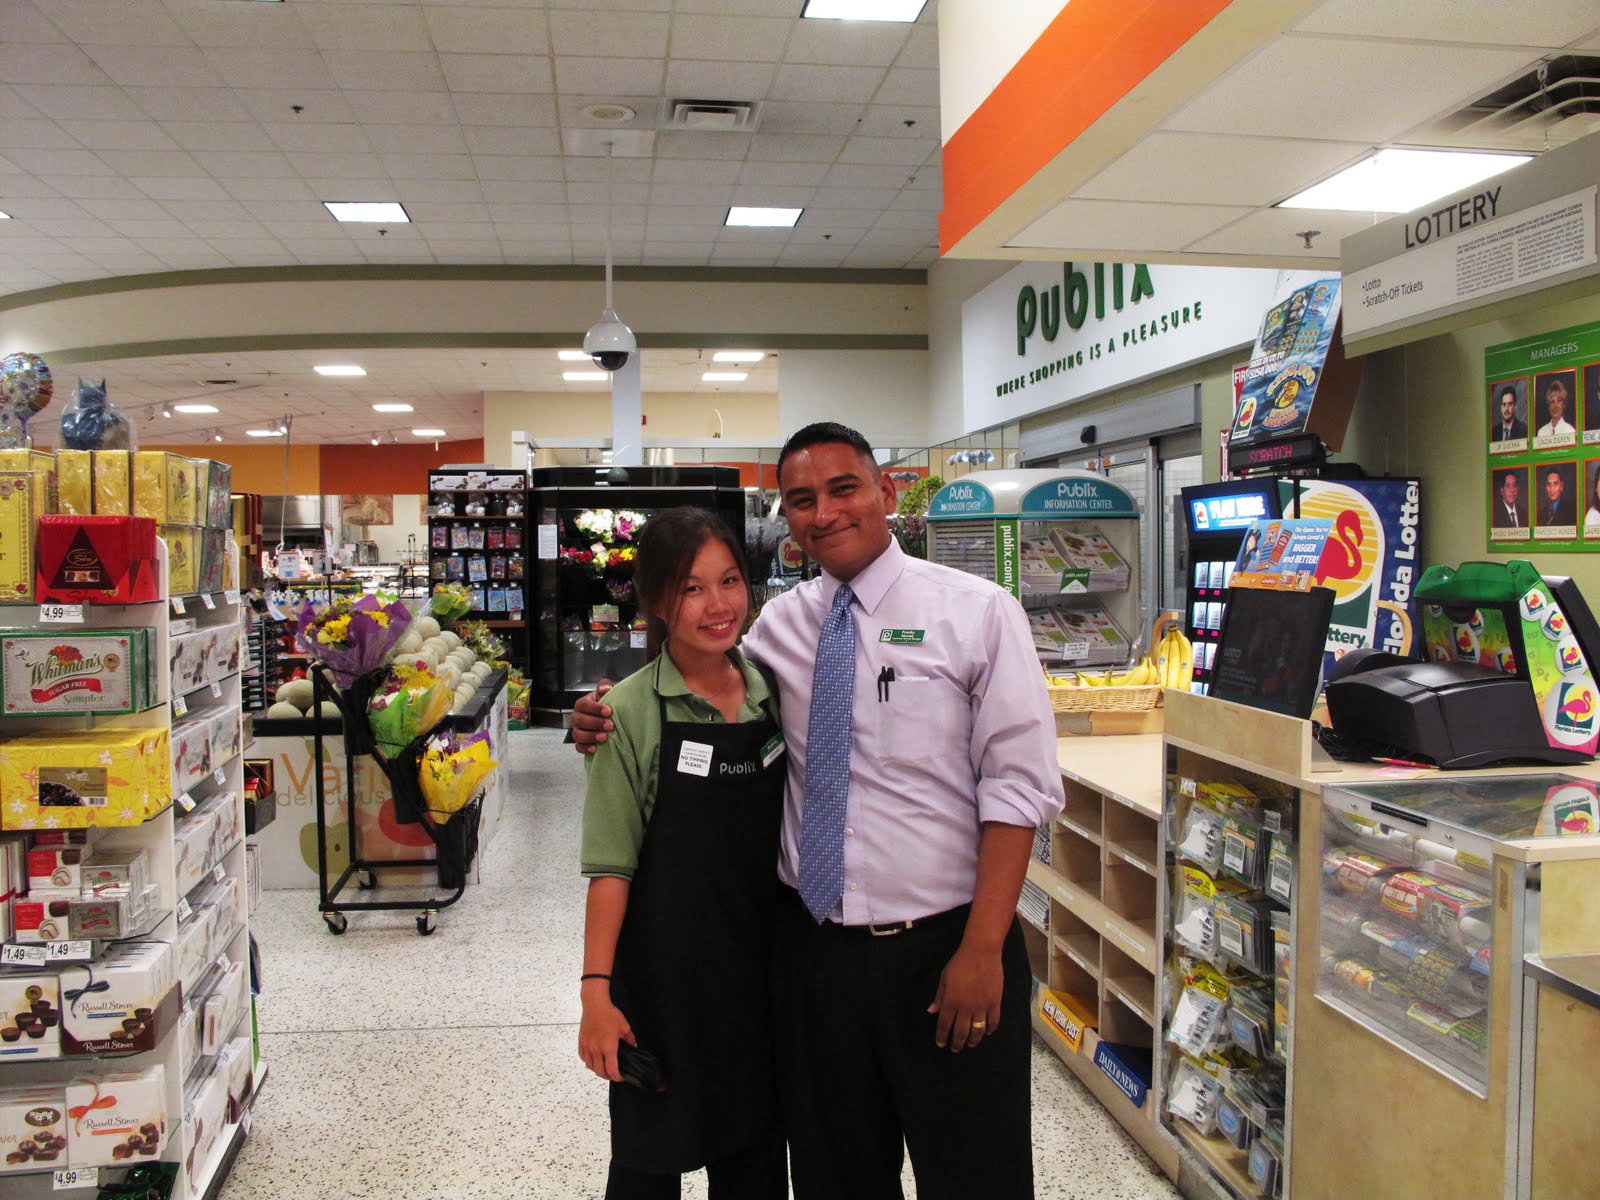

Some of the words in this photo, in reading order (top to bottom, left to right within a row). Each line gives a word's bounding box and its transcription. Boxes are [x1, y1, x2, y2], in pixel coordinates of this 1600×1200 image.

[1405, 186, 1502, 249] LOTTERY
[1365, 277, 1382, 292] Lotto
[1366, 286, 1400, 307] Scratch-Off
[1401, 280, 1423, 295] Tickets
[996, 376, 1026, 398] WHERE
[1030, 350, 1083, 384] SHOPPING
[1090, 343, 1101, 360] IS
[1108, 338, 1116, 353] A
[1122, 301, 1202, 347] PLEASURE
[1530, 342, 1579, 361] MANAGERS
[1248, 444, 1293, 464] SCRATCH
[949, 486, 973, 500] Publix
[1058, 482, 1098, 498] Publix
[1044, 499, 1088, 510] INFORMATION
[1090, 499, 1112, 508] CENTER
[1394, 481, 1419, 560] Lotte
[1292, 544, 1316, 553] BIGGER
[1000, 525, 1014, 595] publix.com/a
[42, 607, 64, 620] $4.99
[1328, 626, 1366, 648] ttery
[26, 653, 104, 686] Whitman's
[48, 682, 70, 698] SUGAR
[70, 680, 88, 689] FREE
[62, 692, 106, 704] Sampler
[1554, 724, 1572, 732] Florida
[720, 761, 756, 775] Publix
[277, 786, 385, 806] delcious
[4, 948, 25, 961] $1.49
[47, 943, 69, 956] $1.49
[79, 1001, 109, 1012] Russell
[110, 1002, 133, 1011] Stover
[1044, 998, 1054, 1018] NEW
[1054, 1008, 1067, 1031] YORK
[1066, 1020, 1080, 1041] POST
[83, 1042, 110, 1051] Russell
[112, 1041, 134, 1049] Stover
[1099, 1051, 1117, 1076] DAILY
[1120, 1071, 1139, 1097] NEWS
[84, 1117, 113, 1130] Russell
[114, 1116, 140, 1125] Stover
[55, 1172, 77, 1185] $4.99
